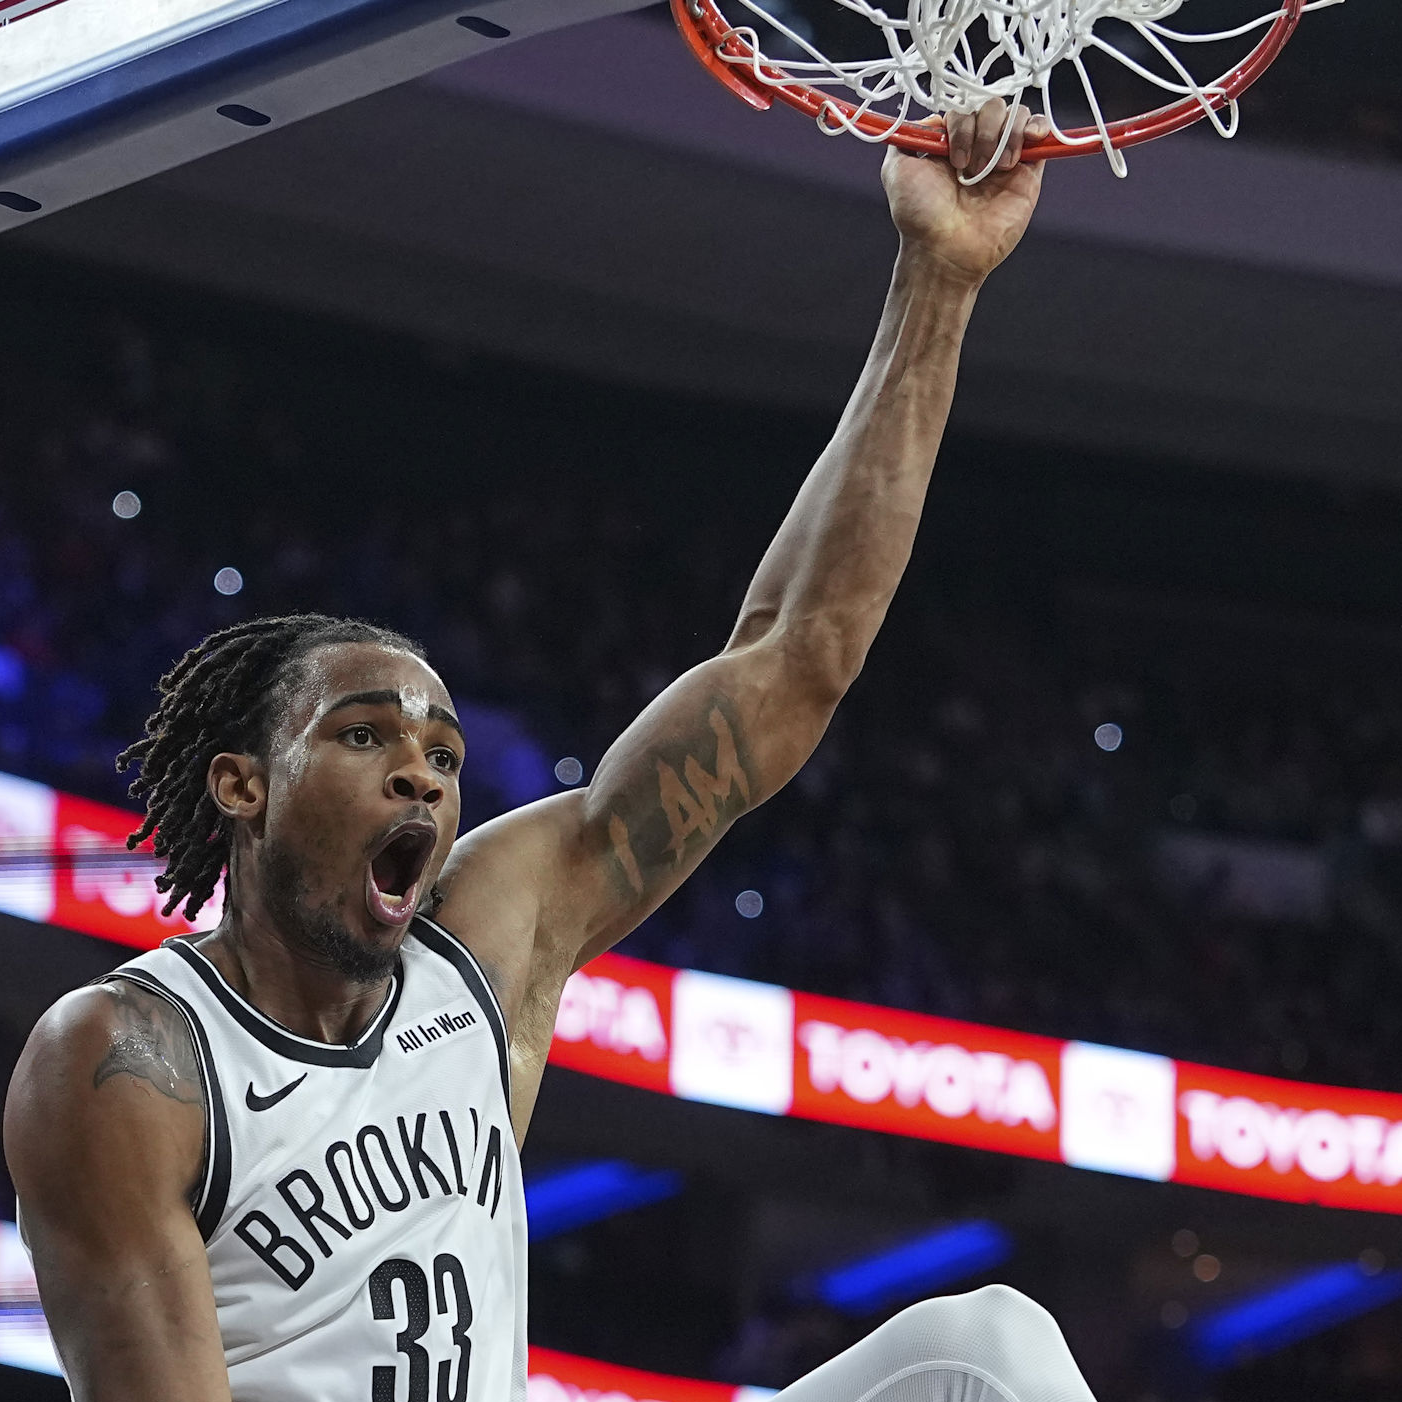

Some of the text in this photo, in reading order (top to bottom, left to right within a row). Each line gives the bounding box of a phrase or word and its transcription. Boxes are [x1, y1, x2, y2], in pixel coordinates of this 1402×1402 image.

[396, 1011, 477, 1053] All In Won
[800, 1019, 1058, 1132] TOYOTA
